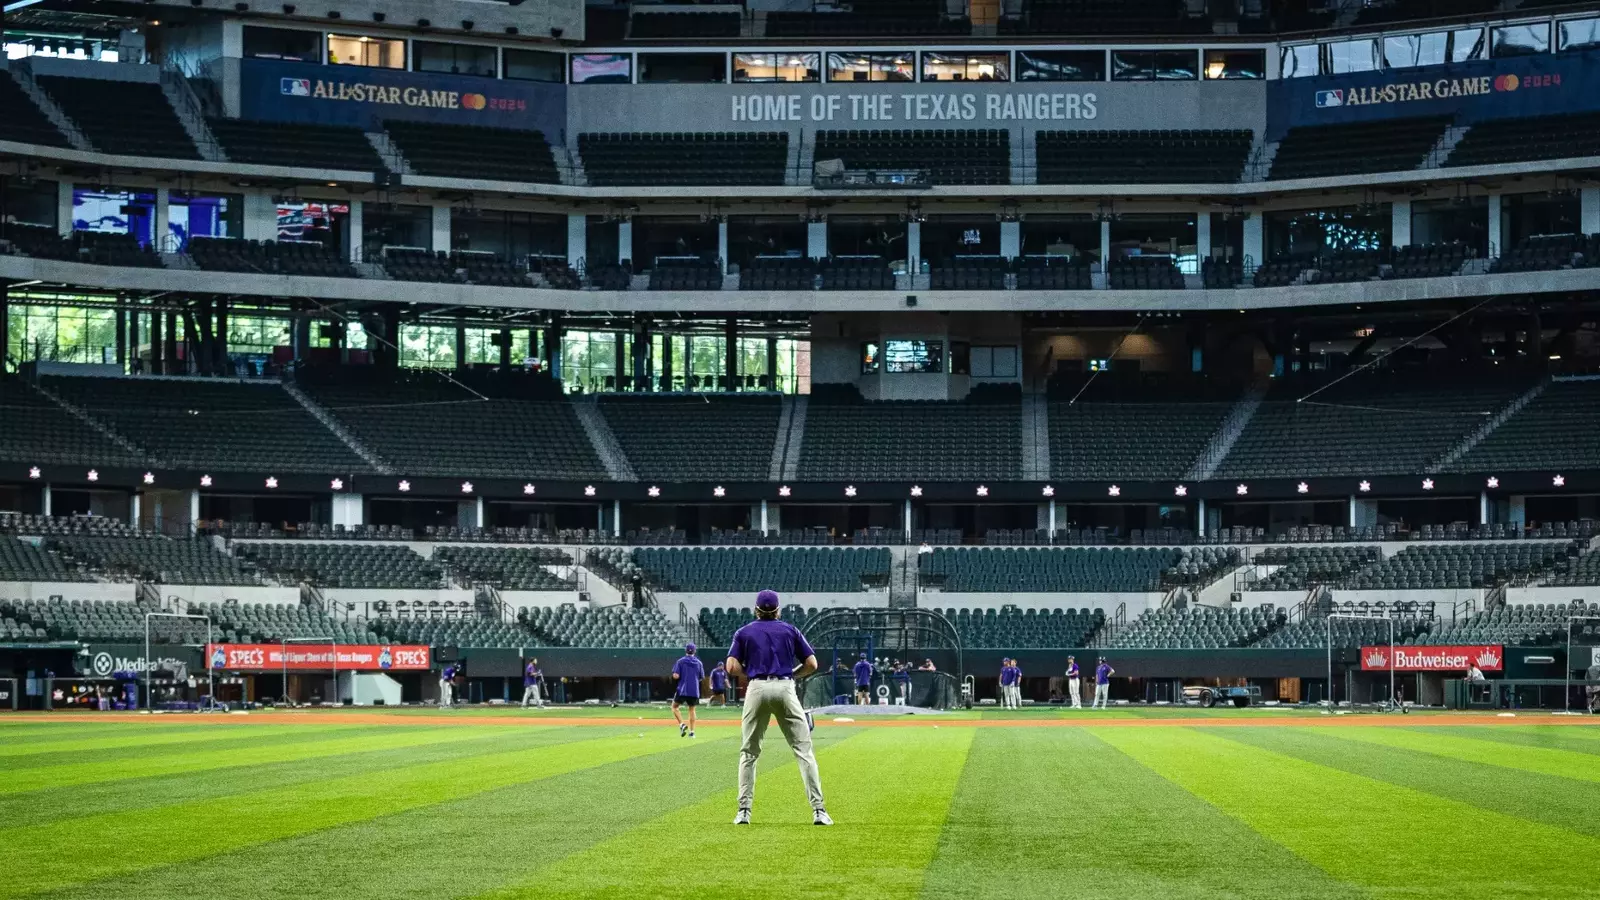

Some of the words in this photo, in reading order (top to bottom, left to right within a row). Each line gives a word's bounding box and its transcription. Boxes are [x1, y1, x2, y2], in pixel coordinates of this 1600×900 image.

[1434, 76, 1492, 98] GAME
[1523, 74, 1562, 88] 2024
[404, 86, 459, 109] GAME
[489, 98, 526, 111] 2024
[732, 94, 802, 121] HOME
[811, 94, 841, 121] OF
[848, 94, 893, 120] THE
[901, 93, 976, 120] TEXAS
[986, 93, 1097, 120] RANGERS
[229, 648, 264, 665] SPEC'S
[395, 648, 427, 665] SPEC'S
[1394, 650, 1469, 668] Budweiser
